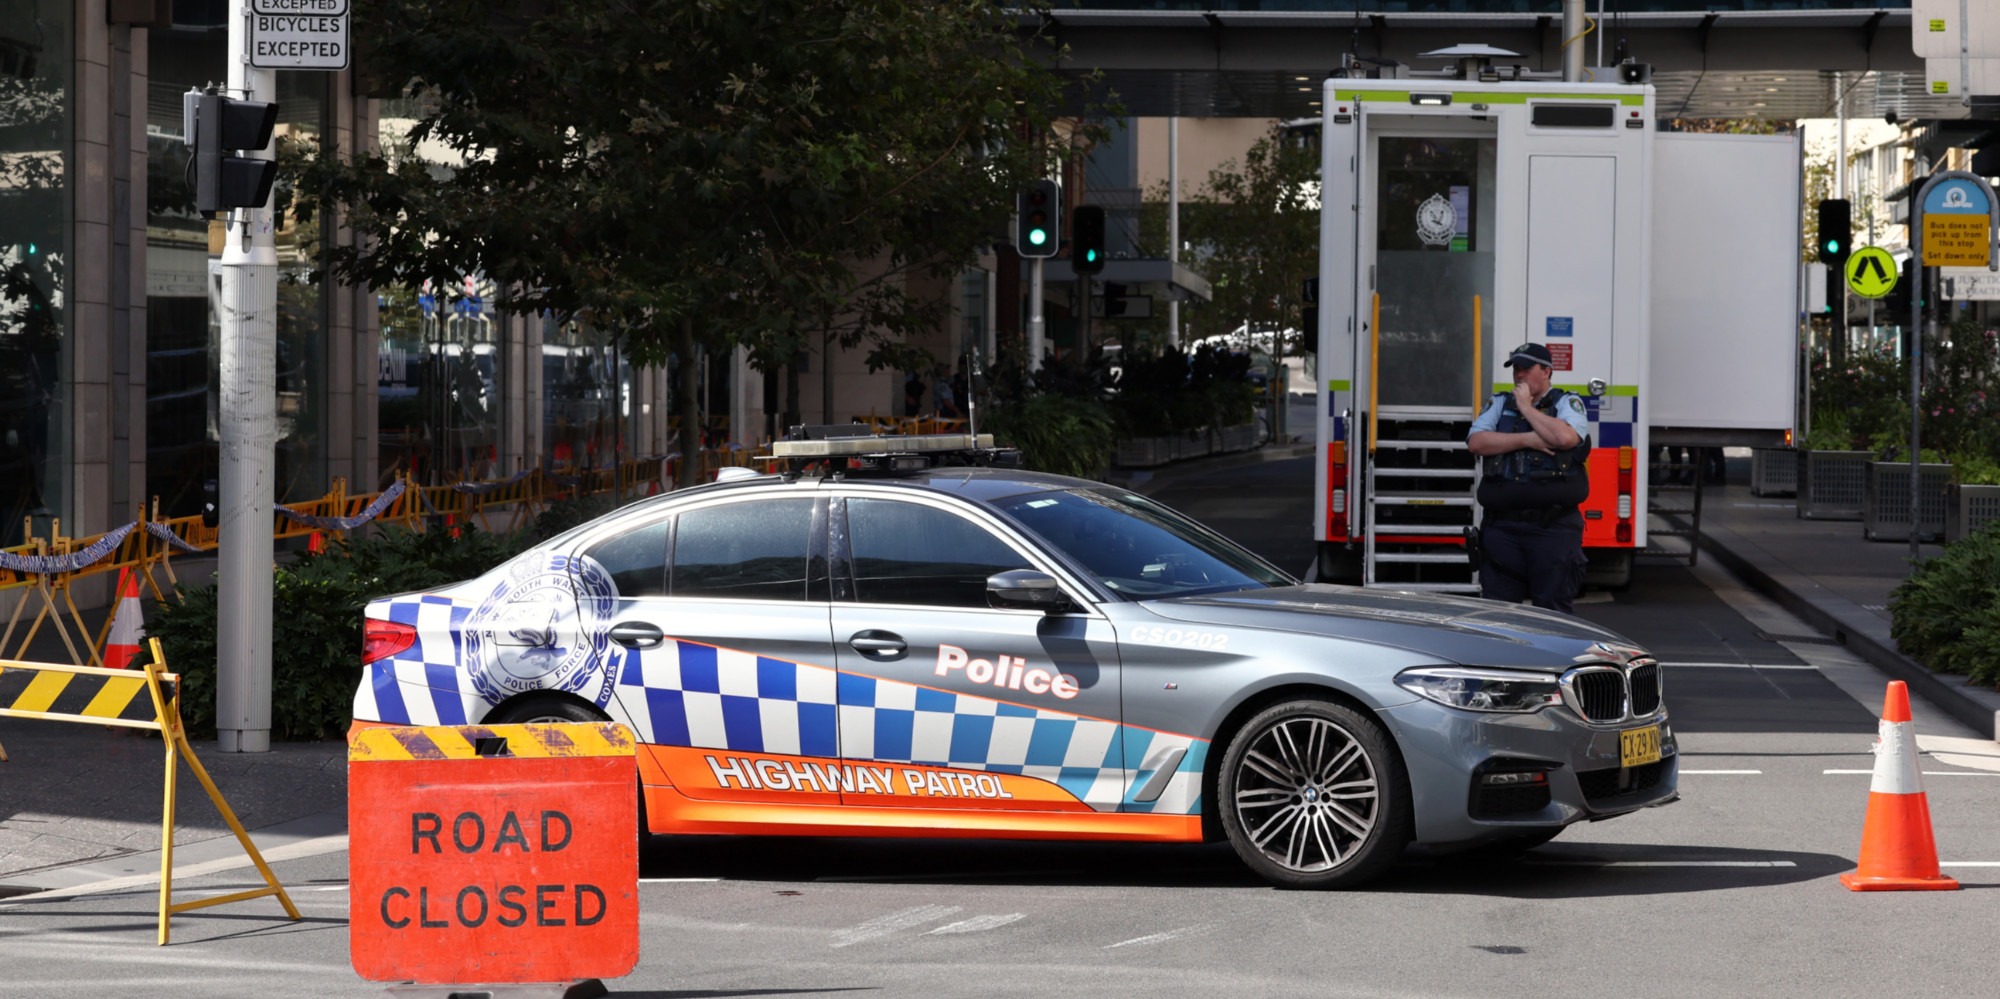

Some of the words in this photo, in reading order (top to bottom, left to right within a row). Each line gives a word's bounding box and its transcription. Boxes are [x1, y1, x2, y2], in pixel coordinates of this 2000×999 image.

[262, 0, 337, 10] EXCEPTED
[259, 17, 340, 33] BICYCLES
[257, 41, 341, 57] EXCEPTED
[1930, 221, 1945, 229] Bus
[1948, 221, 1966, 229] does
[1931, 231, 1947, 239] pick
[1957, 240, 1975, 248] stop
[1968, 252, 1985, 261] only
[508, 578, 542, 604] SOUTH
[504, 677, 544, 690] POLICE
[555, 643, 586, 679] FORCE
[934, 643, 1080, 700] Police
[600, 665, 617, 703] COMES
[705, 755, 895, 795] HIGHWAY
[901, 769, 1014, 799] PATROL
[411, 810, 573, 855] ROAD
[380, 884, 608, 930] CLOSED
